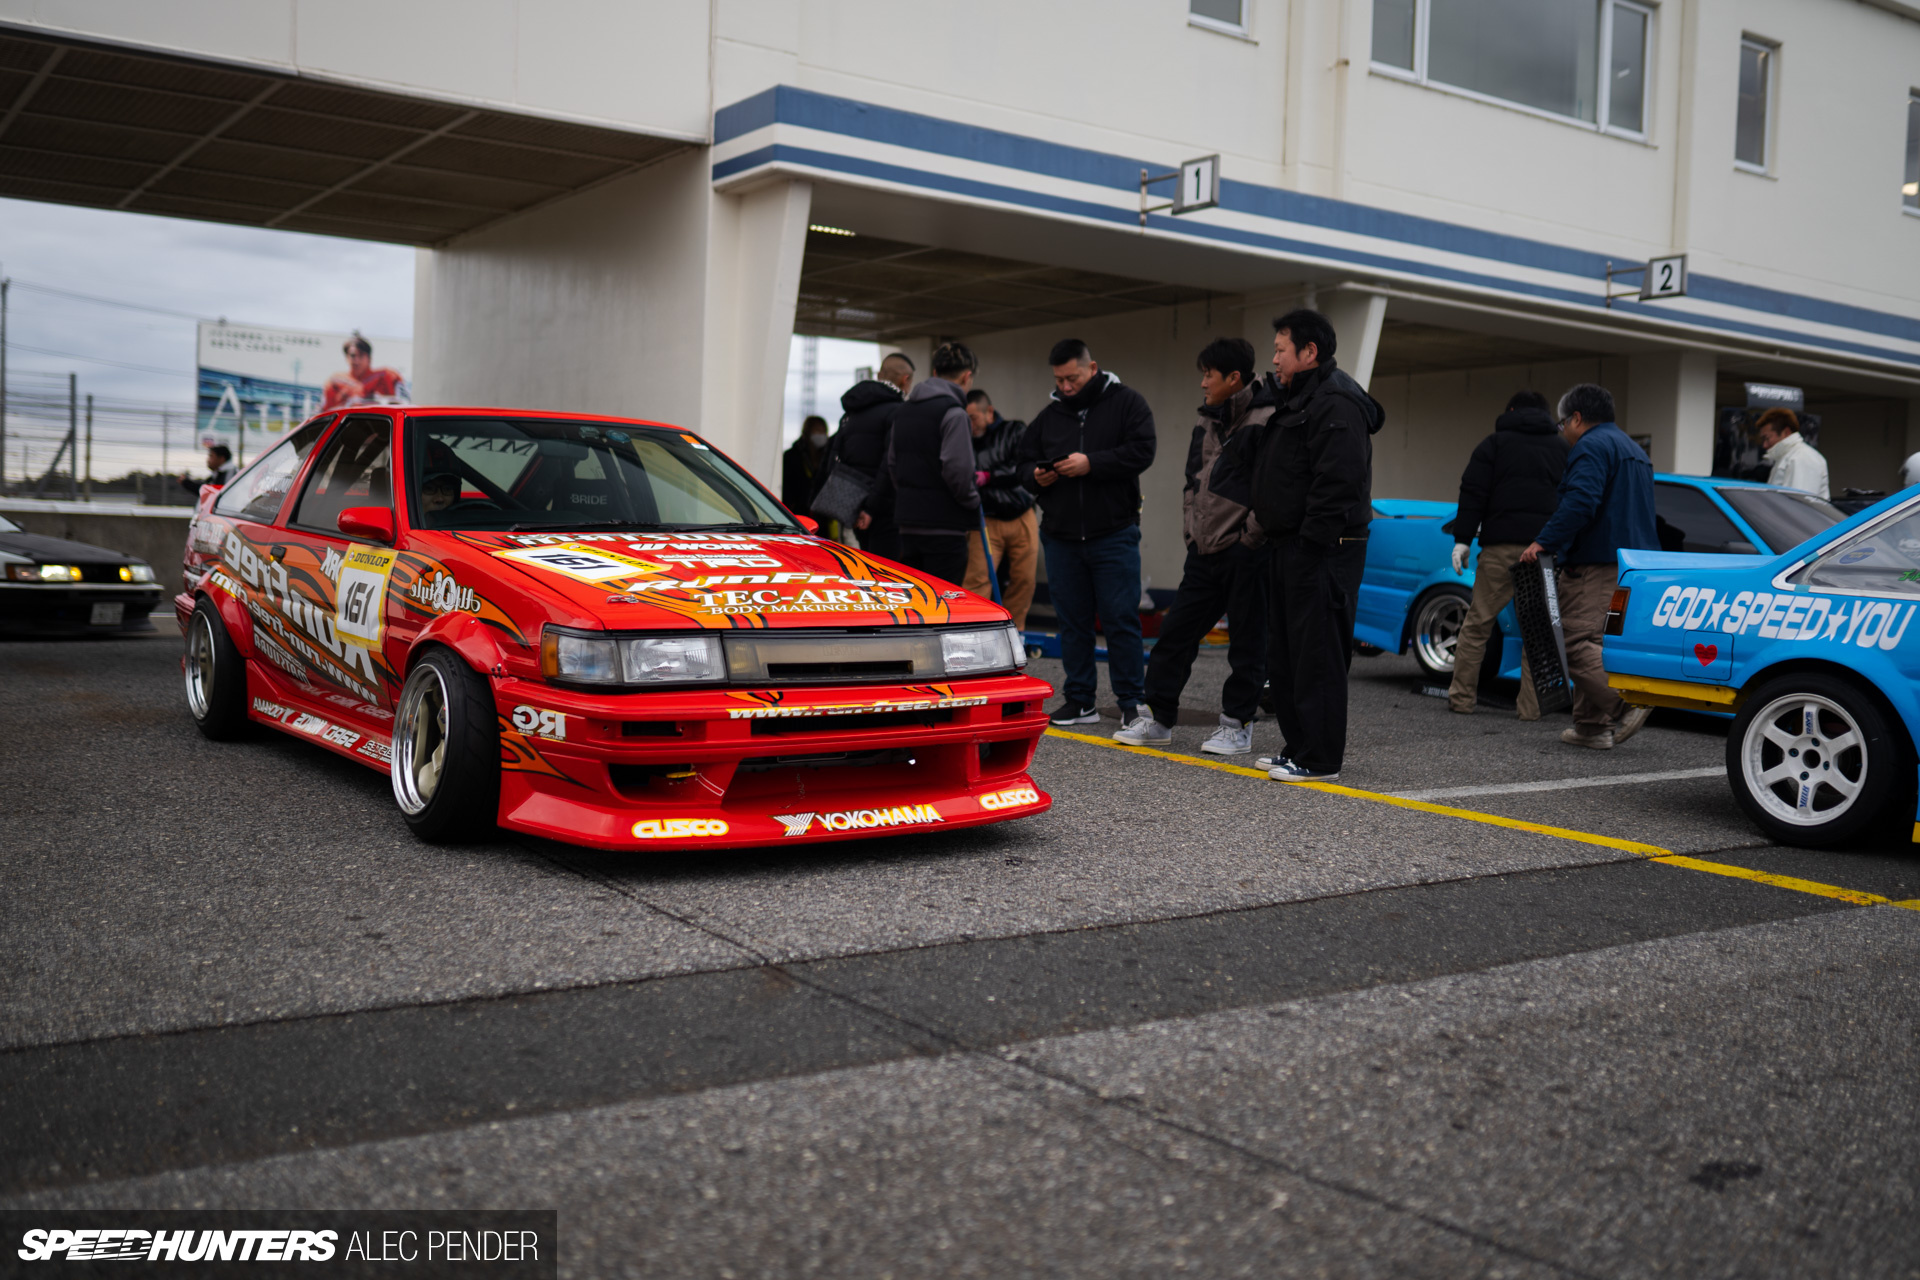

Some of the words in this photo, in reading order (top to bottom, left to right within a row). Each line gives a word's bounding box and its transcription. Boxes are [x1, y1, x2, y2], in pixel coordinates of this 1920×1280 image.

[1193, 166, 1202, 201] 1
[1659, 263, 1675, 292] 2
[570, 494, 608, 505] BRIDE
[353, 552, 390, 568] DUNLOP
[528, 553, 620, 569] 161
[663, 558, 783, 569] TRD
[625, 572, 914, 592] RunFree
[344, 580, 376, 626] 161
[694, 590, 910, 607] TEC-ART'S
[711, 605, 763, 615] BODY
[772, 604, 849, 613] MAKING
[853, 603, 899, 611] SHOP
[1652, 585, 1717, 630] GOD
[1722, 591, 1832, 641] SPEED
[1841, 600, 1918, 651] YOU
[728, 696, 988, 719] www.run-free.com
[815, 804, 944, 831] YOKOHAMA
